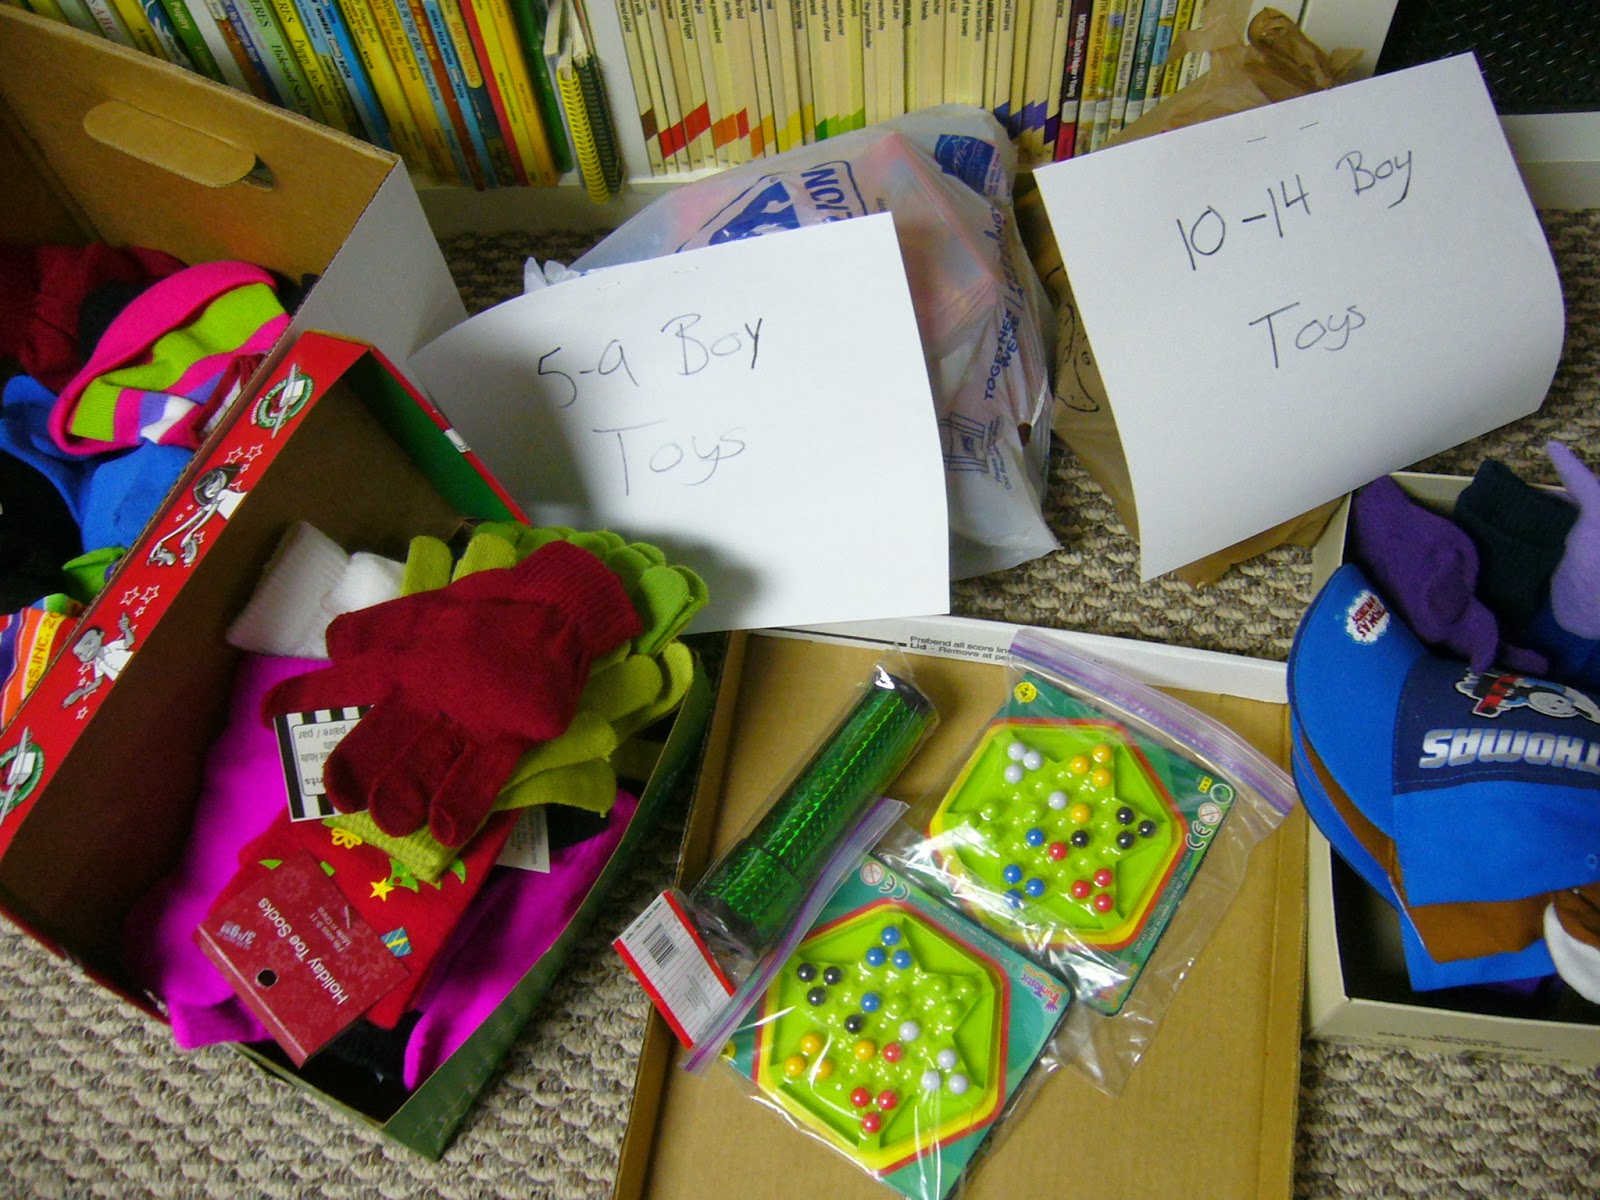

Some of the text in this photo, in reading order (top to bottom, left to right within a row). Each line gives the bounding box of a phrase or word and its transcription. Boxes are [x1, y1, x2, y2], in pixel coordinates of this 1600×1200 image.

[171, 0, 193, 32] Puppy
[1096, 14, 1105, 36] Woman
[458, 44, 478, 84] CHRISTMAS
[1090, 46, 1102, 69] Courage
[1176, 150, 1412, 271] 10-14 Boy
[1248, 301, 1366, 368] Toys
[538, 339, 639, 409] 5-9
[592, 419, 746, 496] Toys
[910, 635, 951, 647] Prebend
[953, 640, 965, 648] all
[967, 643, 994, 652] score
[910, 642, 927, 650] Lid
[938, 646, 980, 657] Remove
[298, 729, 314, 739] par
[323, 726, 347, 736] paire
[1419, 728, 1600, 775] THOMAS
[257, 896, 350, 1006] Holiday Toe Socks
